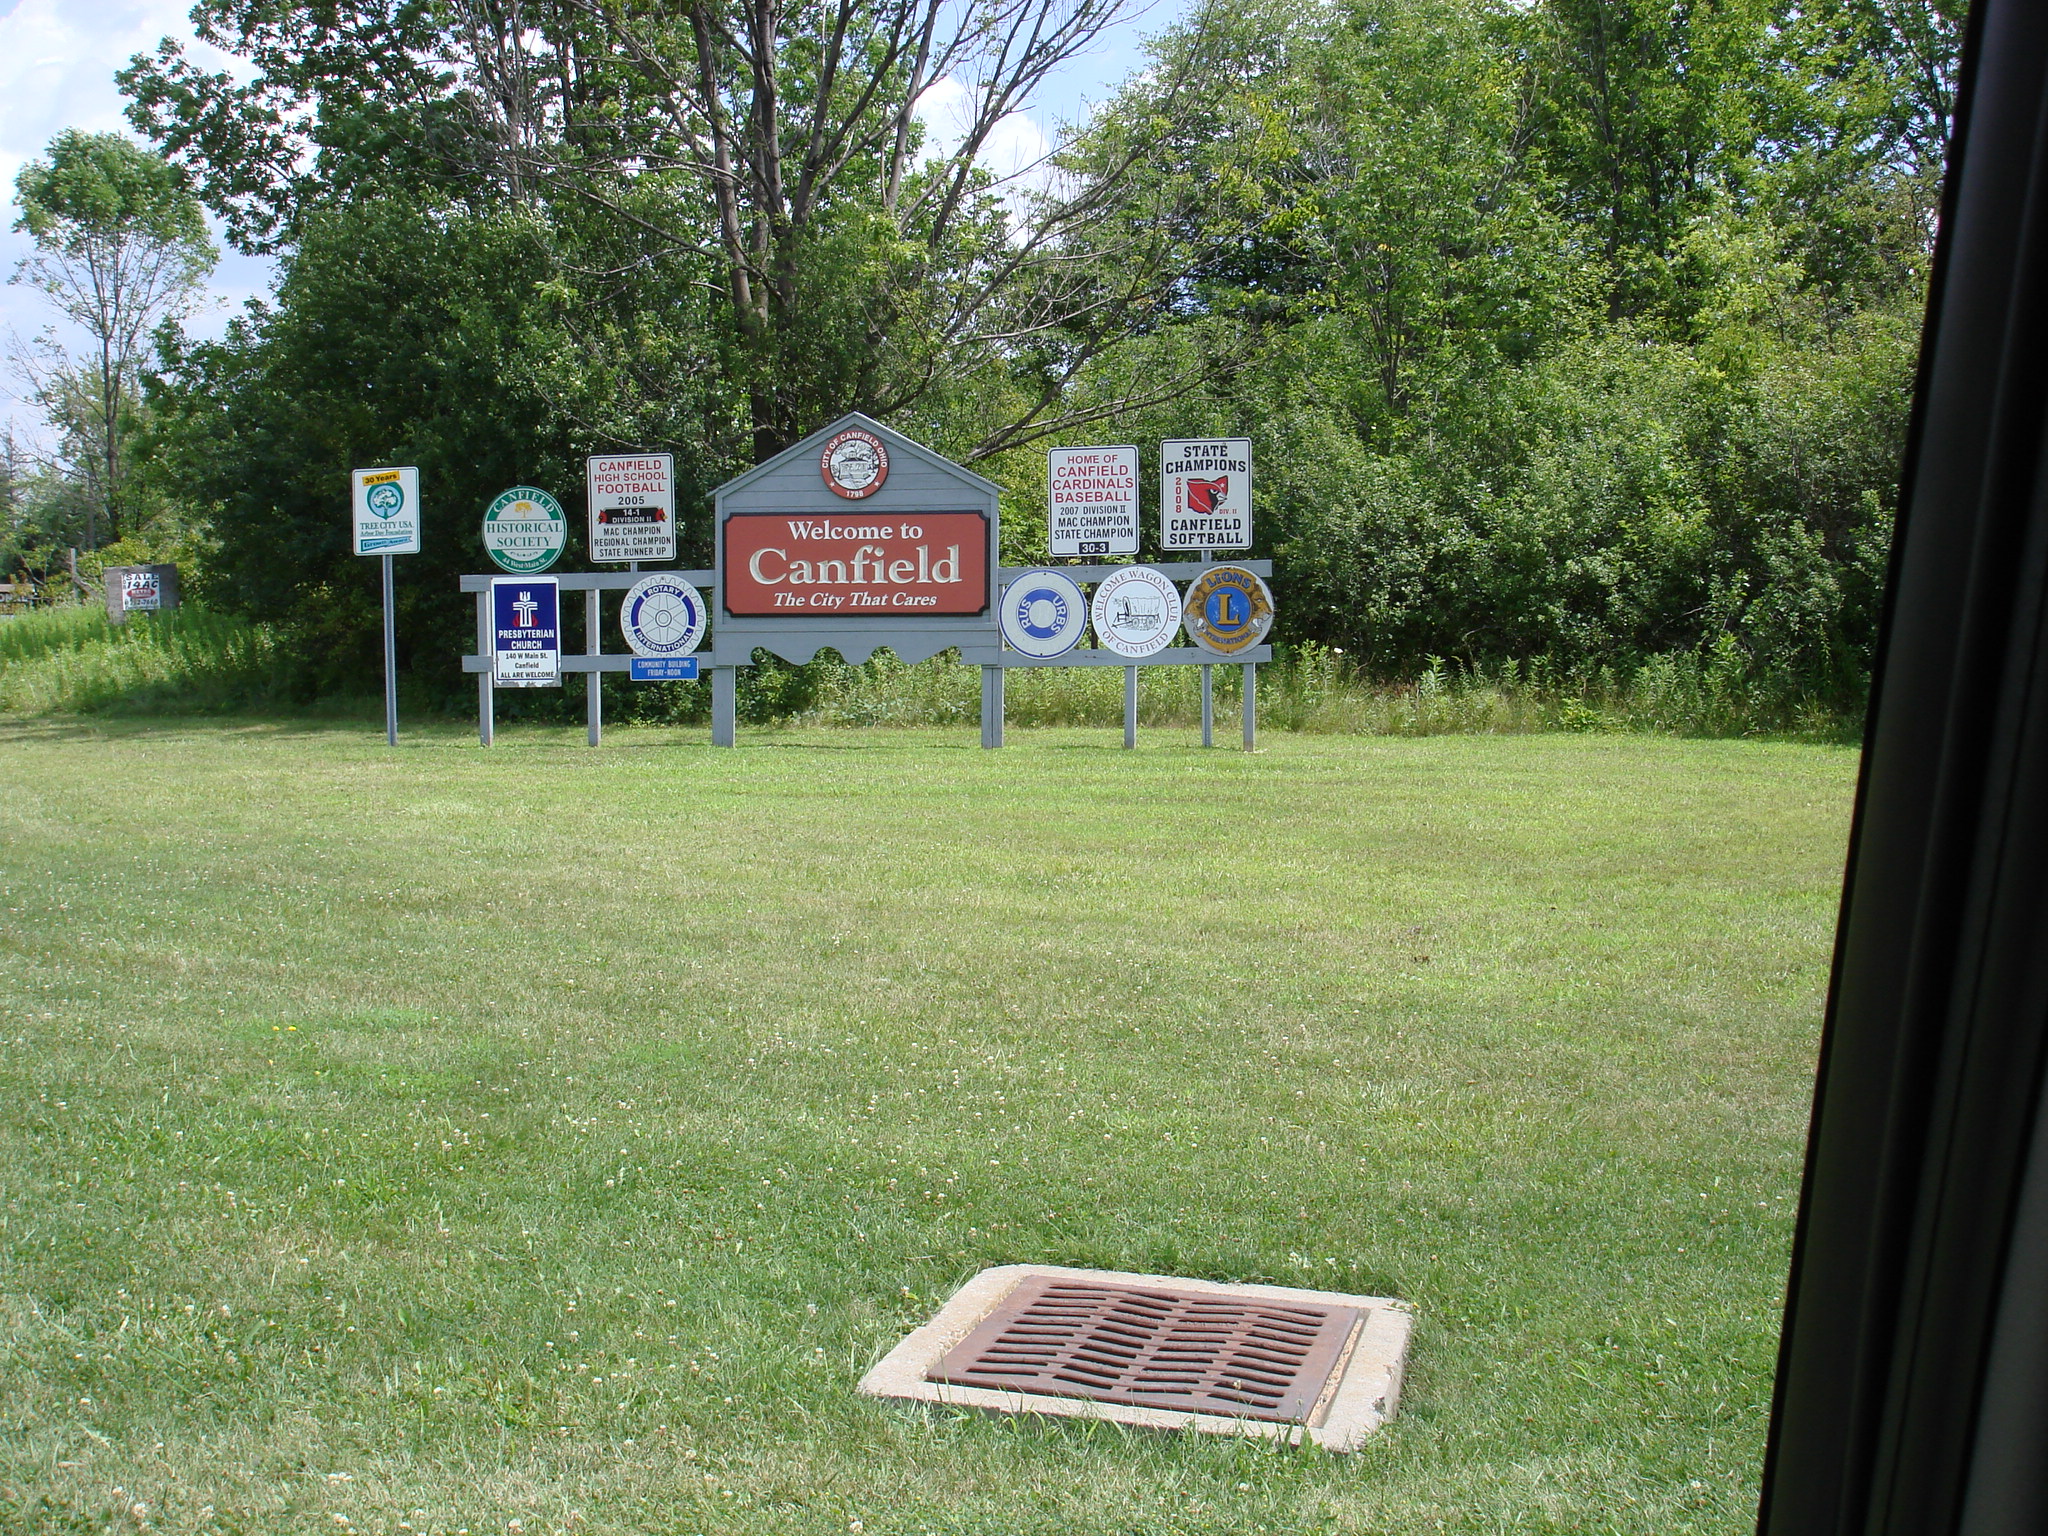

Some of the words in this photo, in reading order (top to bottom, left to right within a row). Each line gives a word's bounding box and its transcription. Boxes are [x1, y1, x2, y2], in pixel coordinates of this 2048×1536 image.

[822, 450, 831, 468] CITY
[829, 438, 840, 449] OF
[840, 432, 878, 446] CANFIELD
[877, 448, 888, 468] OHIO
[1184, 445, 1228, 458] STATE
[1068, 455, 1099, 464] HOME
[1104, 454, 1118, 463] OF
[599, 460, 662, 472] CANFIELD
[1058, 465, 1128, 477] CANFIELD
[1166, 460, 1246, 474] CHAMPIONS
[376, 474, 397, 482] Years
[594, 474, 620, 482] HIGH
[624, 472, 668, 481] SCHOOL
[598, 482, 664, 494] FOOTBALL
[1052, 478, 1134, 490] CARDINALS
[494, 491, 554, 512] CANFIELD
[618, 496, 644, 505] 2005
[1056, 491, 1131, 503] BASEBALL
[623, 508, 640, 516] 14-1
[1060, 506, 1078, 516] 2007
[1083, 505, 1118, 514] DIVISION
[380, 522, 397, 530] CITY
[487, 523, 562, 533] HISTORICAL
[1058, 517, 1078, 528] MAC
[1080, 516, 1130, 526] CHAMPION
[1171, 519, 1240, 530] CANFIELD
[604, 528, 620, 536] MAC
[622, 526, 661, 535] CHAMPION
[787, 520, 894, 540] Welcome
[900, 522, 924, 540] to
[1054, 529, 1082, 540] STATE
[1084, 528, 1133, 538] CHAMPION
[497, 537, 551, 547] SOCIETY
[594, 538, 630, 546] REGIONAL
[632, 536, 671, 546] CHAMPION
[1170, 532, 1242, 544] SOFTBALL
[600, 548, 620, 557] STATE
[624, 547, 654, 556] RUNNER
[656, 547, 666, 555] UP
[1082, 544, 1106, 552] 30-3
[749, 544, 962, 585] Canfield
[1206, 571, 1252, 589] LIONS
[646, 586, 680, 596] ROTARY
[1096, 574, 1127, 621] WELCOME
[1129, 570, 1169, 590] WAGON
[1166, 592, 1178, 622] CLUB
[774, 592, 806, 607] The
[810, 592, 844, 610] City
[850, 592, 889, 606] That
[892, 592, 937, 606] Cares
[1216, 594, 1240, 624] L
[498, 630, 554, 638] PRESBYTERIAN
[511, 640, 542, 650] CHURCH
[636, 632, 692, 652] INTERNATIONAL
[1102, 630, 1116, 644] OF
[1116, 632, 1168, 654] CANFIELD
